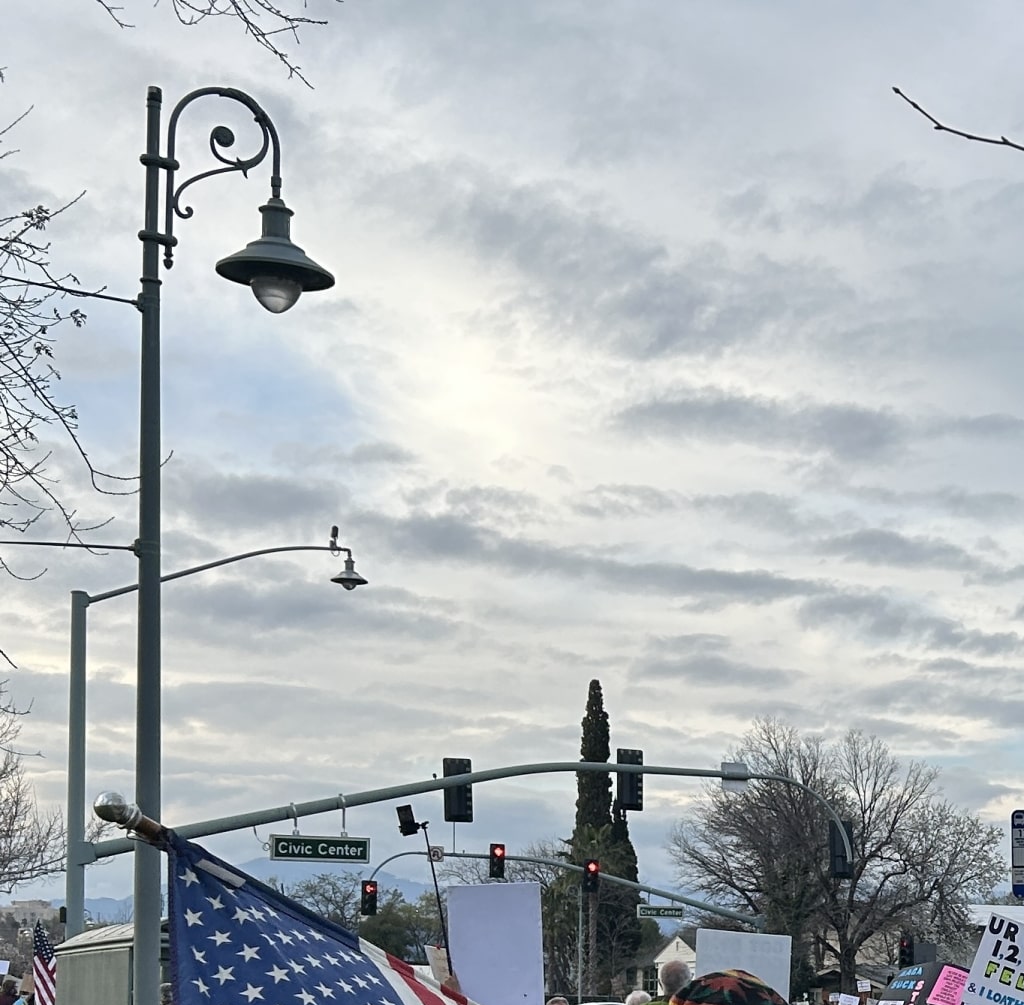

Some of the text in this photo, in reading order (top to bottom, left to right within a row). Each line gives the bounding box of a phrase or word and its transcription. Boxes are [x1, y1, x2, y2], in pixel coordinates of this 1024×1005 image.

[277, 841, 364, 857] Civic Center
[659, 908, 682, 916] Center
[988, 916, 1019, 942] UR
[967, 982, 976, 994] &
[978, 986, 986, 997] I
